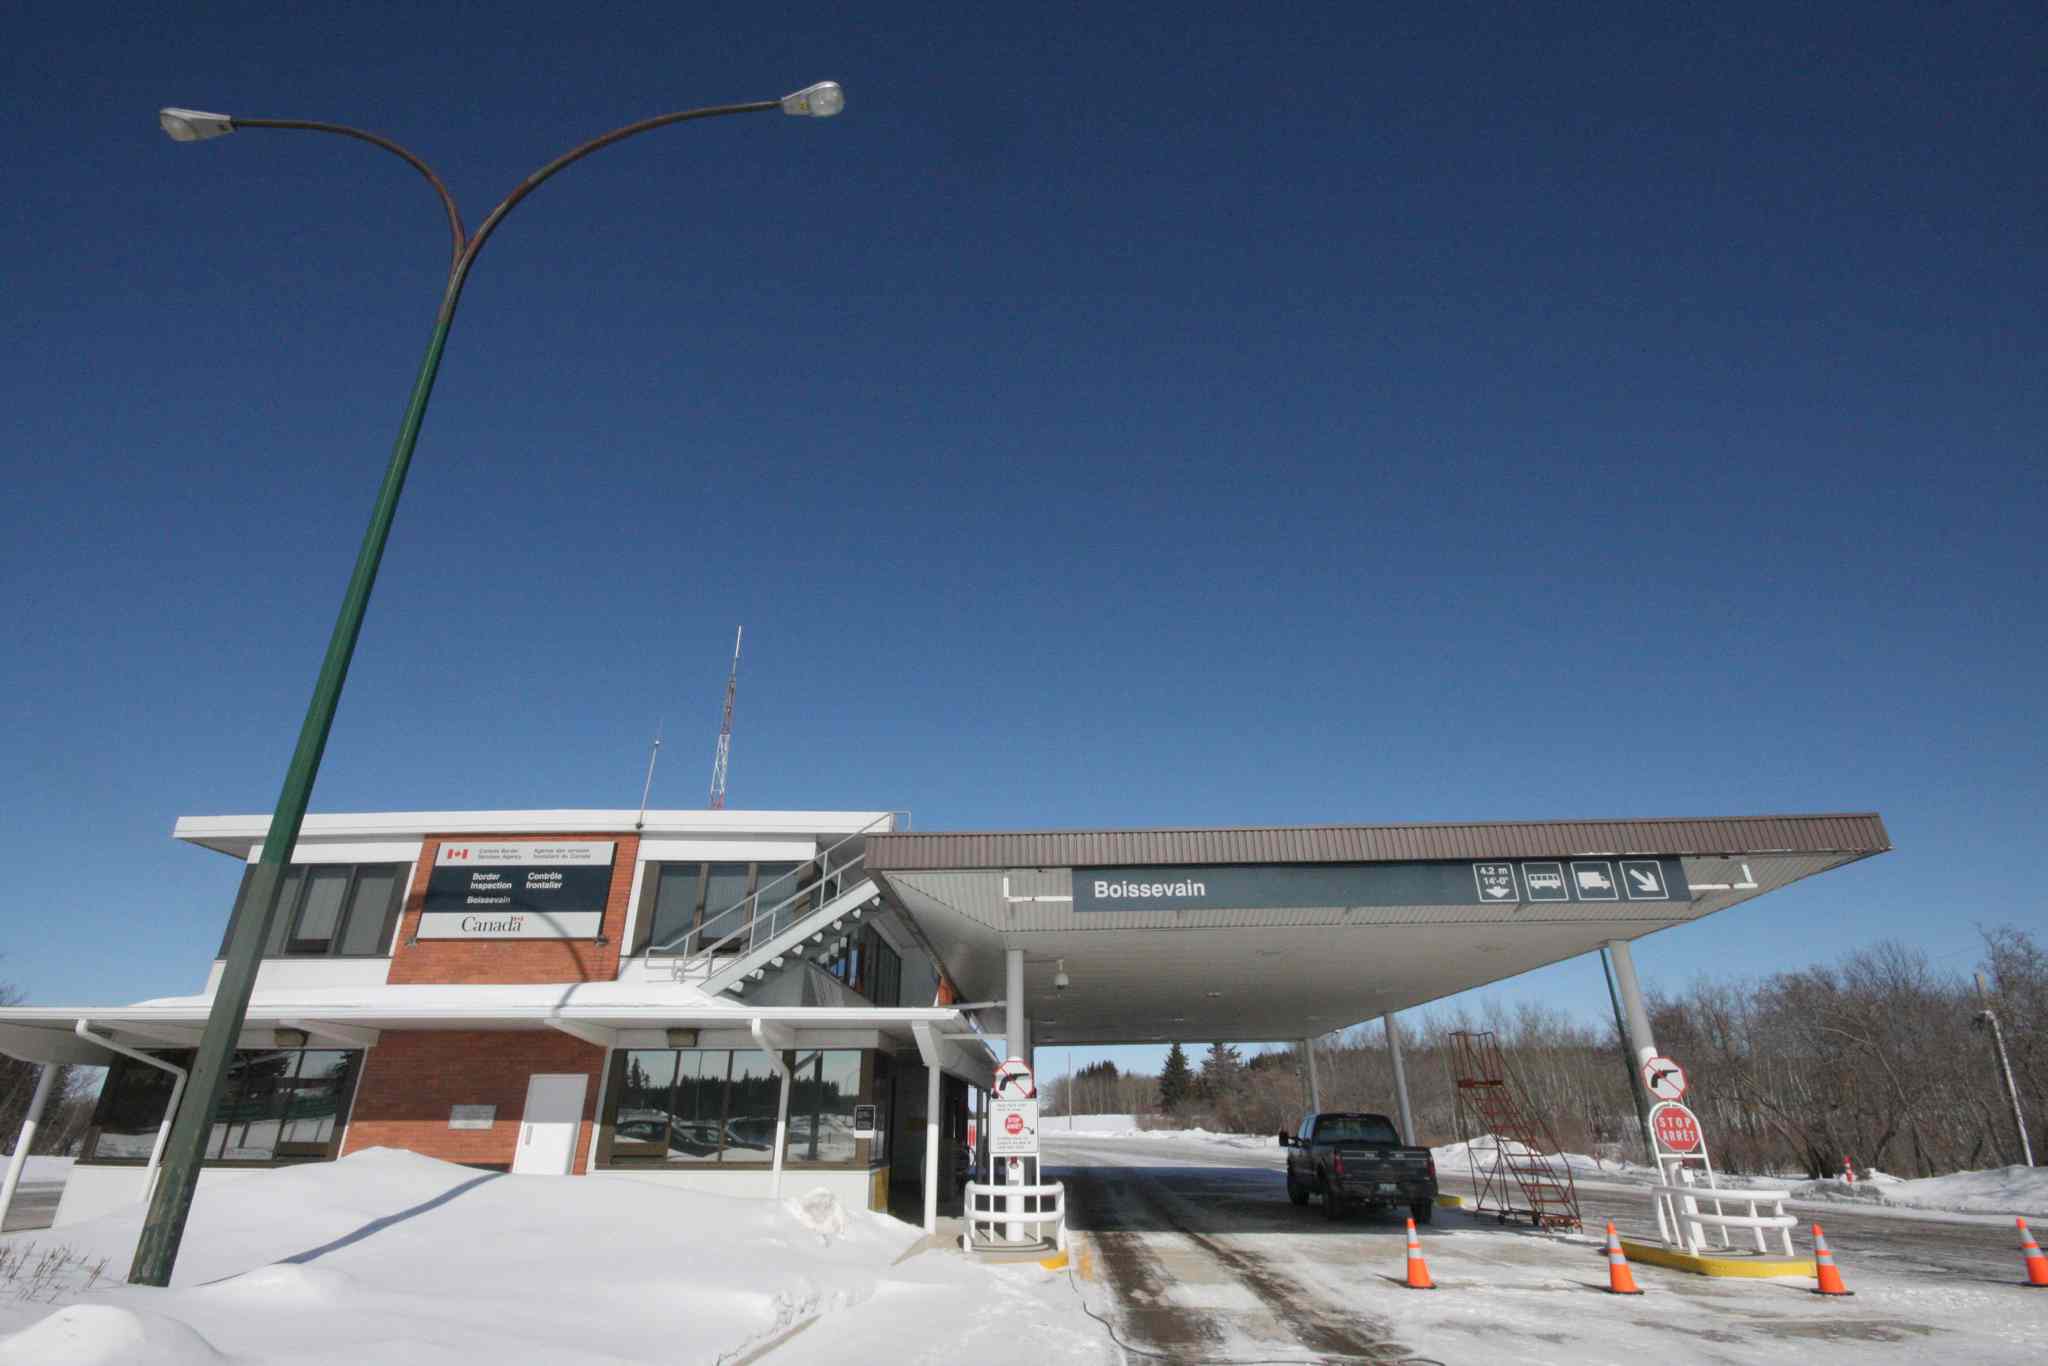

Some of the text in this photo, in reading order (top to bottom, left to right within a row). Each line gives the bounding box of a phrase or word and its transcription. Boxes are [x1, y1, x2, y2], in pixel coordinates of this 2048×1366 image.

[1480, 867, 1495, 875] 4.2
[472, 872, 500, 881] Border
[527, 872, 562, 880] Contrôle
[470, 881, 512, 890] Inspection
[526, 881, 562, 889] frontalier
[1094, 880, 1206, 898] Boissevain
[467, 896, 511, 904] Boissevain
[462, 914, 521, 933] Canada
[1658, 1117, 1691, 1129] STOP
